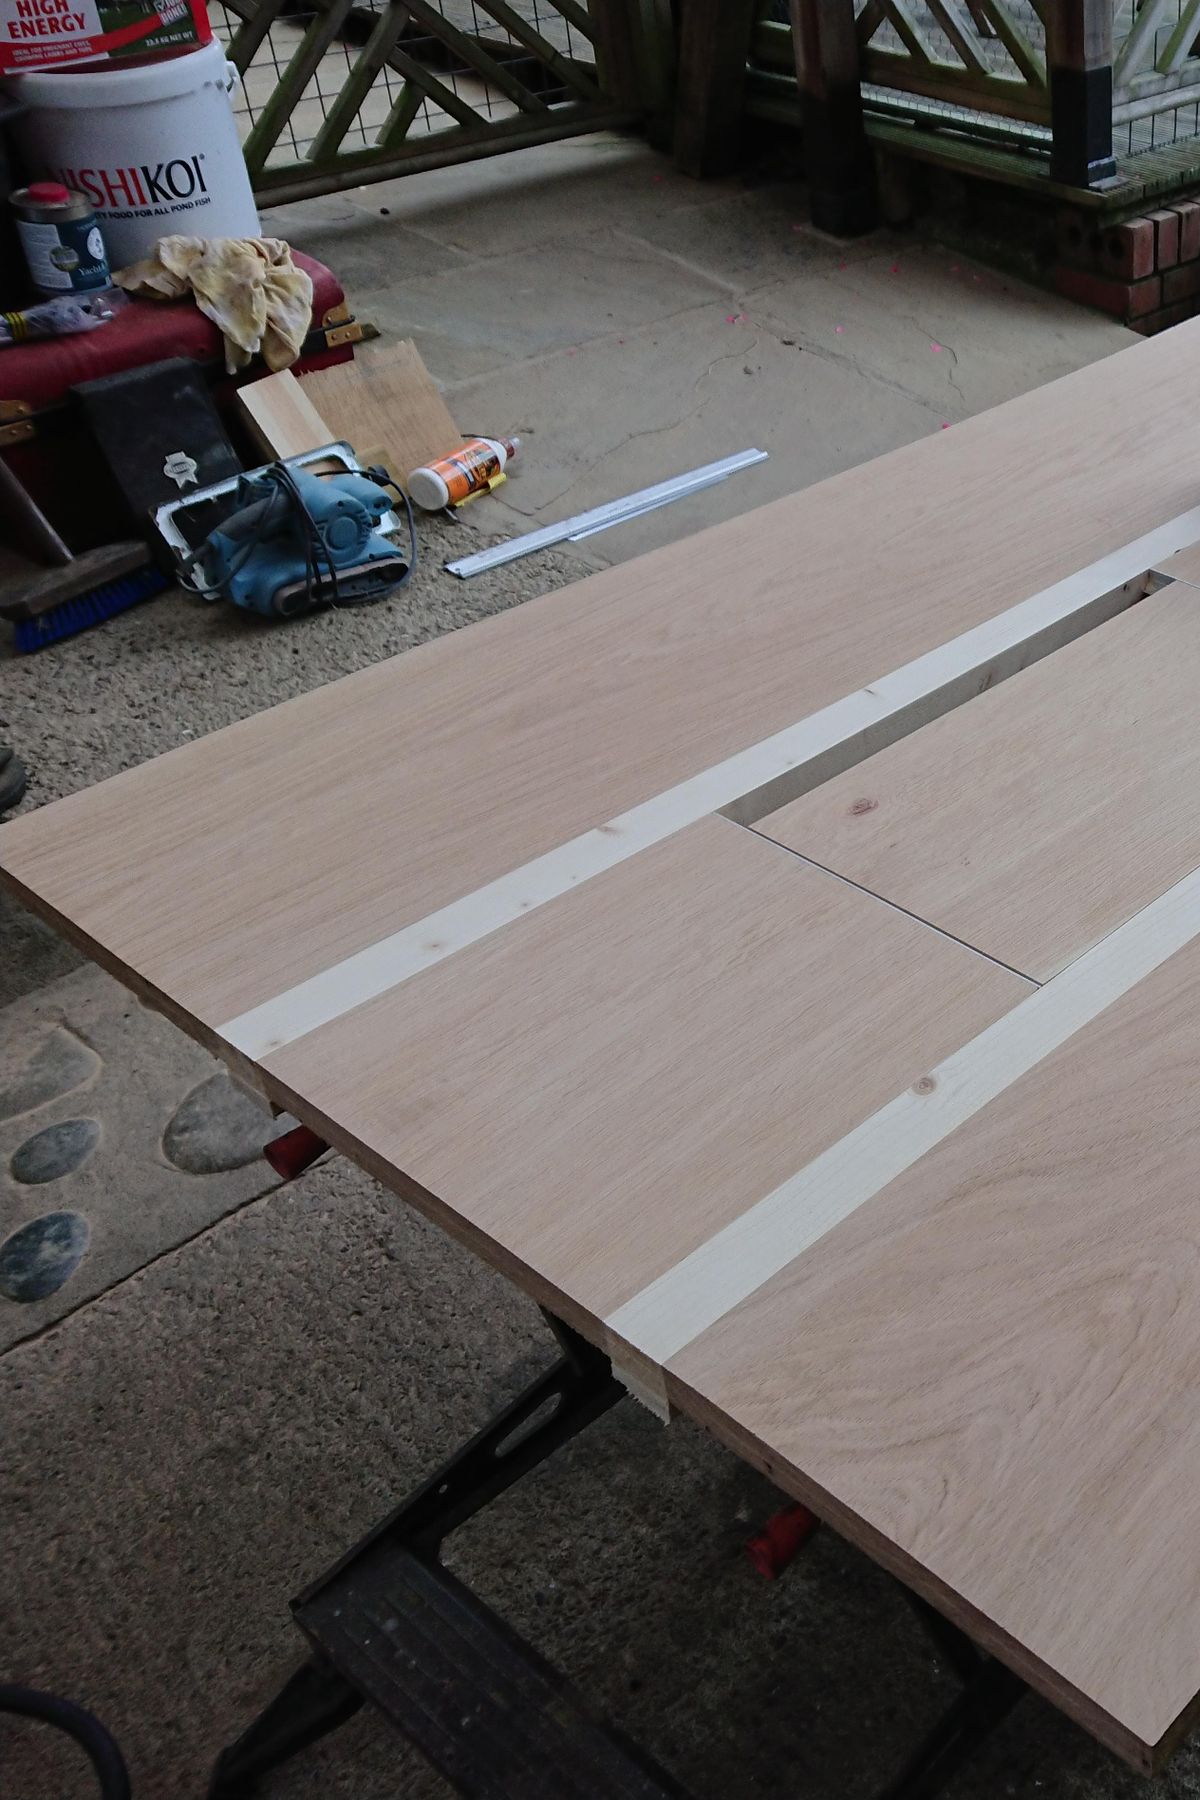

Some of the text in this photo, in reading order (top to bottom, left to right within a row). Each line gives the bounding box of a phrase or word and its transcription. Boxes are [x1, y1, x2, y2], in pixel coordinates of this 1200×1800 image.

[16, 0, 69, 17] HIGH
[7, 13, 85, 39] ENERGY
[109, 210, 133, 219] FOOD
[134, 209, 153, 218] FOR
[154, 207, 169, 216] ALL
[171, 202, 194, 212] POND
[195, 197, 211, 207] FISH
